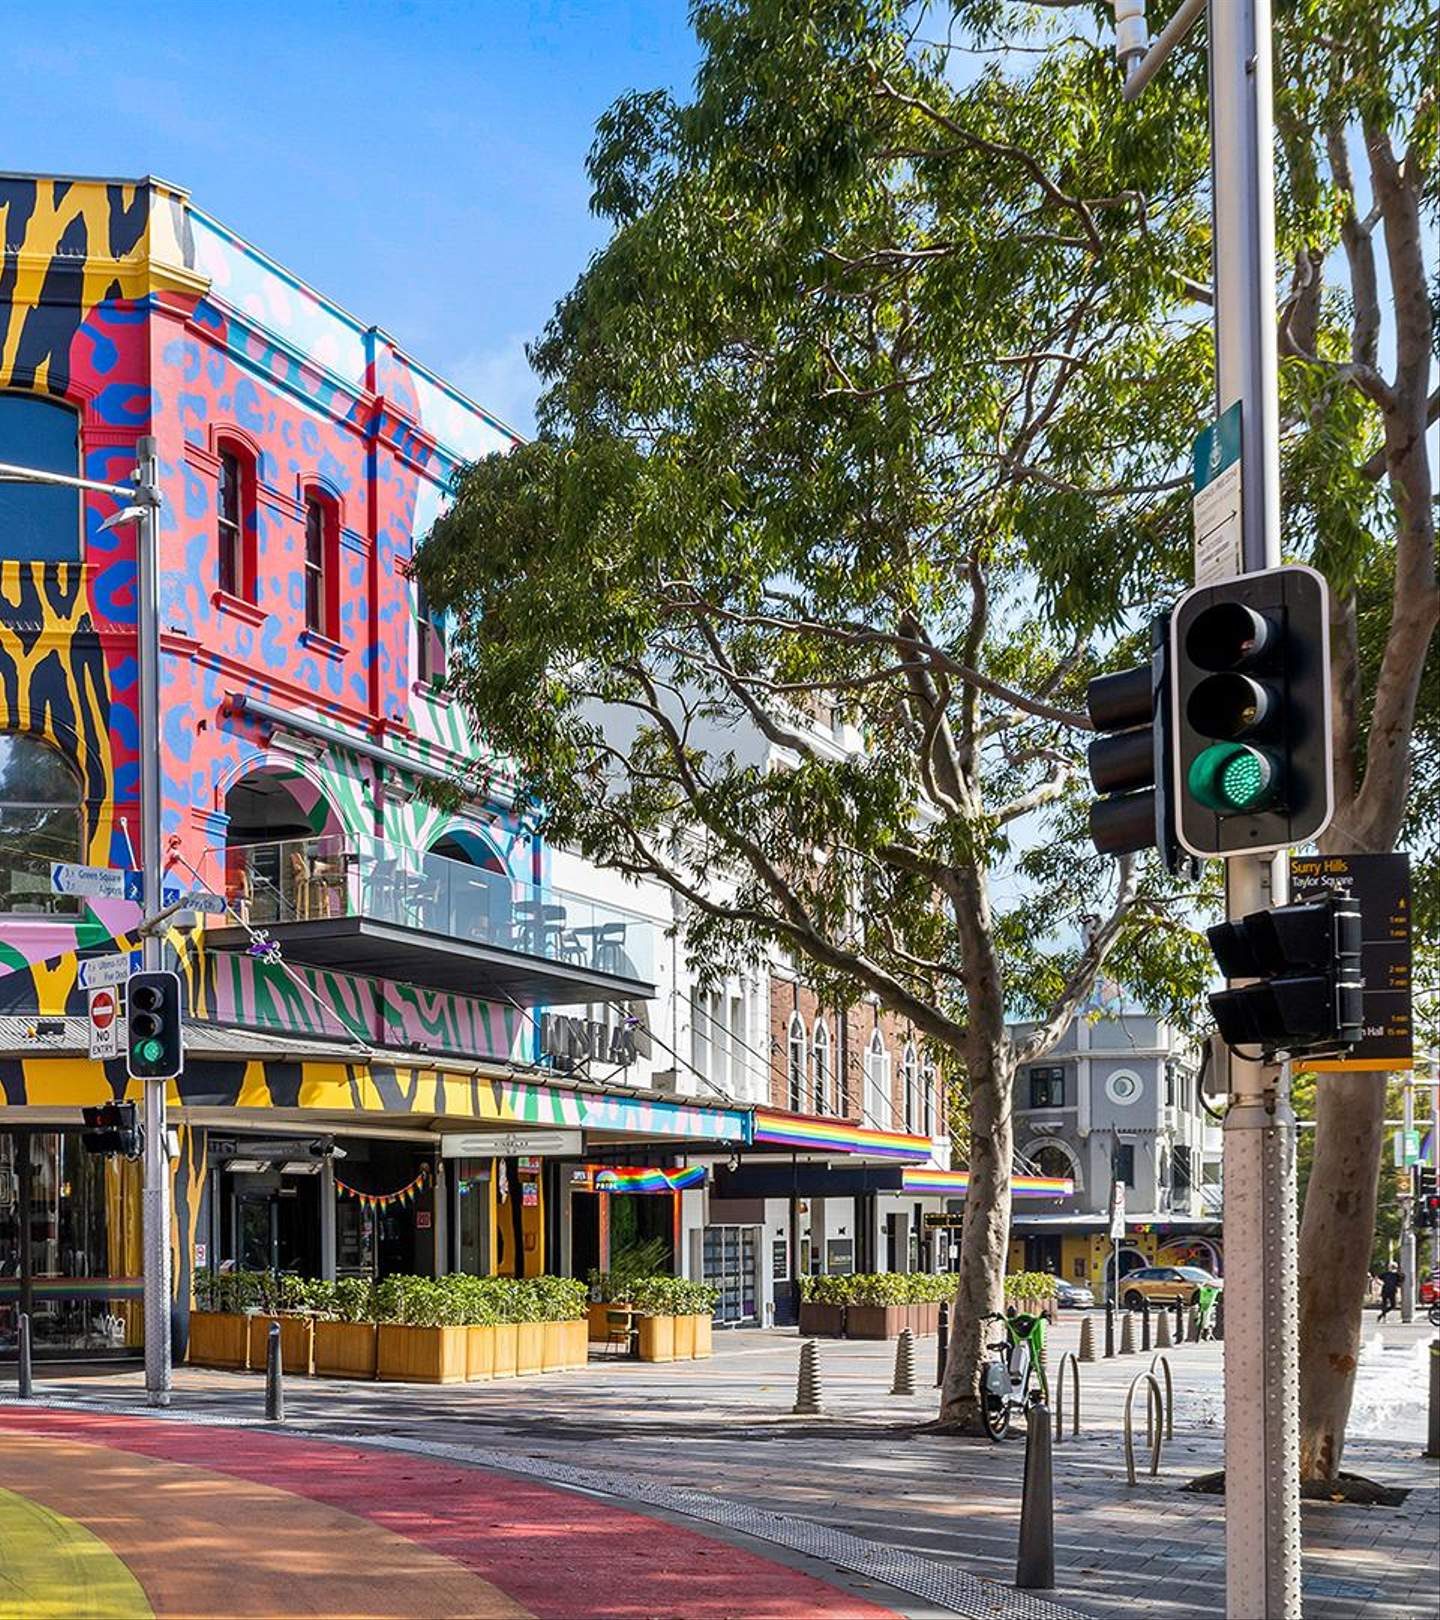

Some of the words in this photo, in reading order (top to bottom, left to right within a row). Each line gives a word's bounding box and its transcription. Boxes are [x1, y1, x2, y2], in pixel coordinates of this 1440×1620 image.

[1291, 861, 1320, 876] Surry
[1324, 859, 1348, 872] Hills
[1292, 875, 1318, 889] Taylor
[1321, 875, 1353, 887] Square
[96, 1030, 110, 1042] NO
[1367, 1026, 1384, 1036] Hall
[93, 1043, 113, 1055] ENTRY
